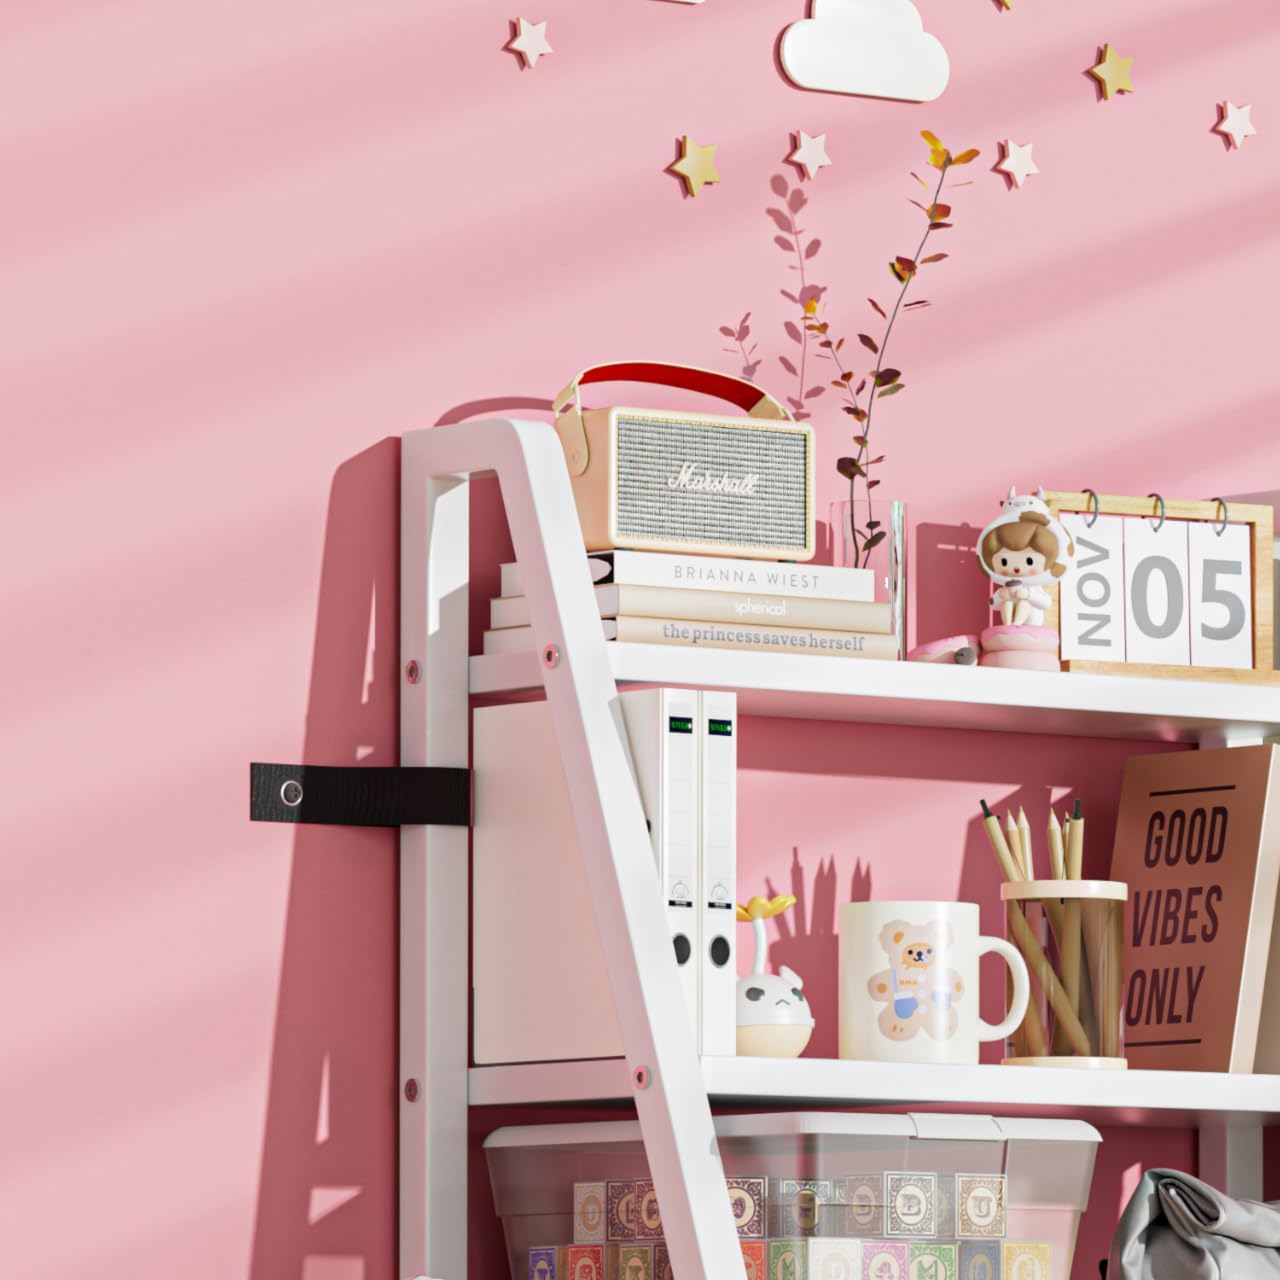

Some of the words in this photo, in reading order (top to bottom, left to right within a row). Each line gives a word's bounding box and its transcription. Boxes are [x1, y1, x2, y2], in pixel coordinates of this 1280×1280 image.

[668, 462, 759, 495] Marshall
[673, 565, 757, 584] BRIANNA
[767, 572, 820, 591] WIEST
[1076, 536, 1112, 647] NOV
[663, 624, 689, 640] the
[692, 627, 761, 644] princess
[762, 632, 807, 648] saves
[809, 633, 865, 652] herself
[1144, 805, 1229, 868] GOOD
[1132, 885, 1223, 948] VIBES
[1125, 965, 1206, 1027] ONLY
